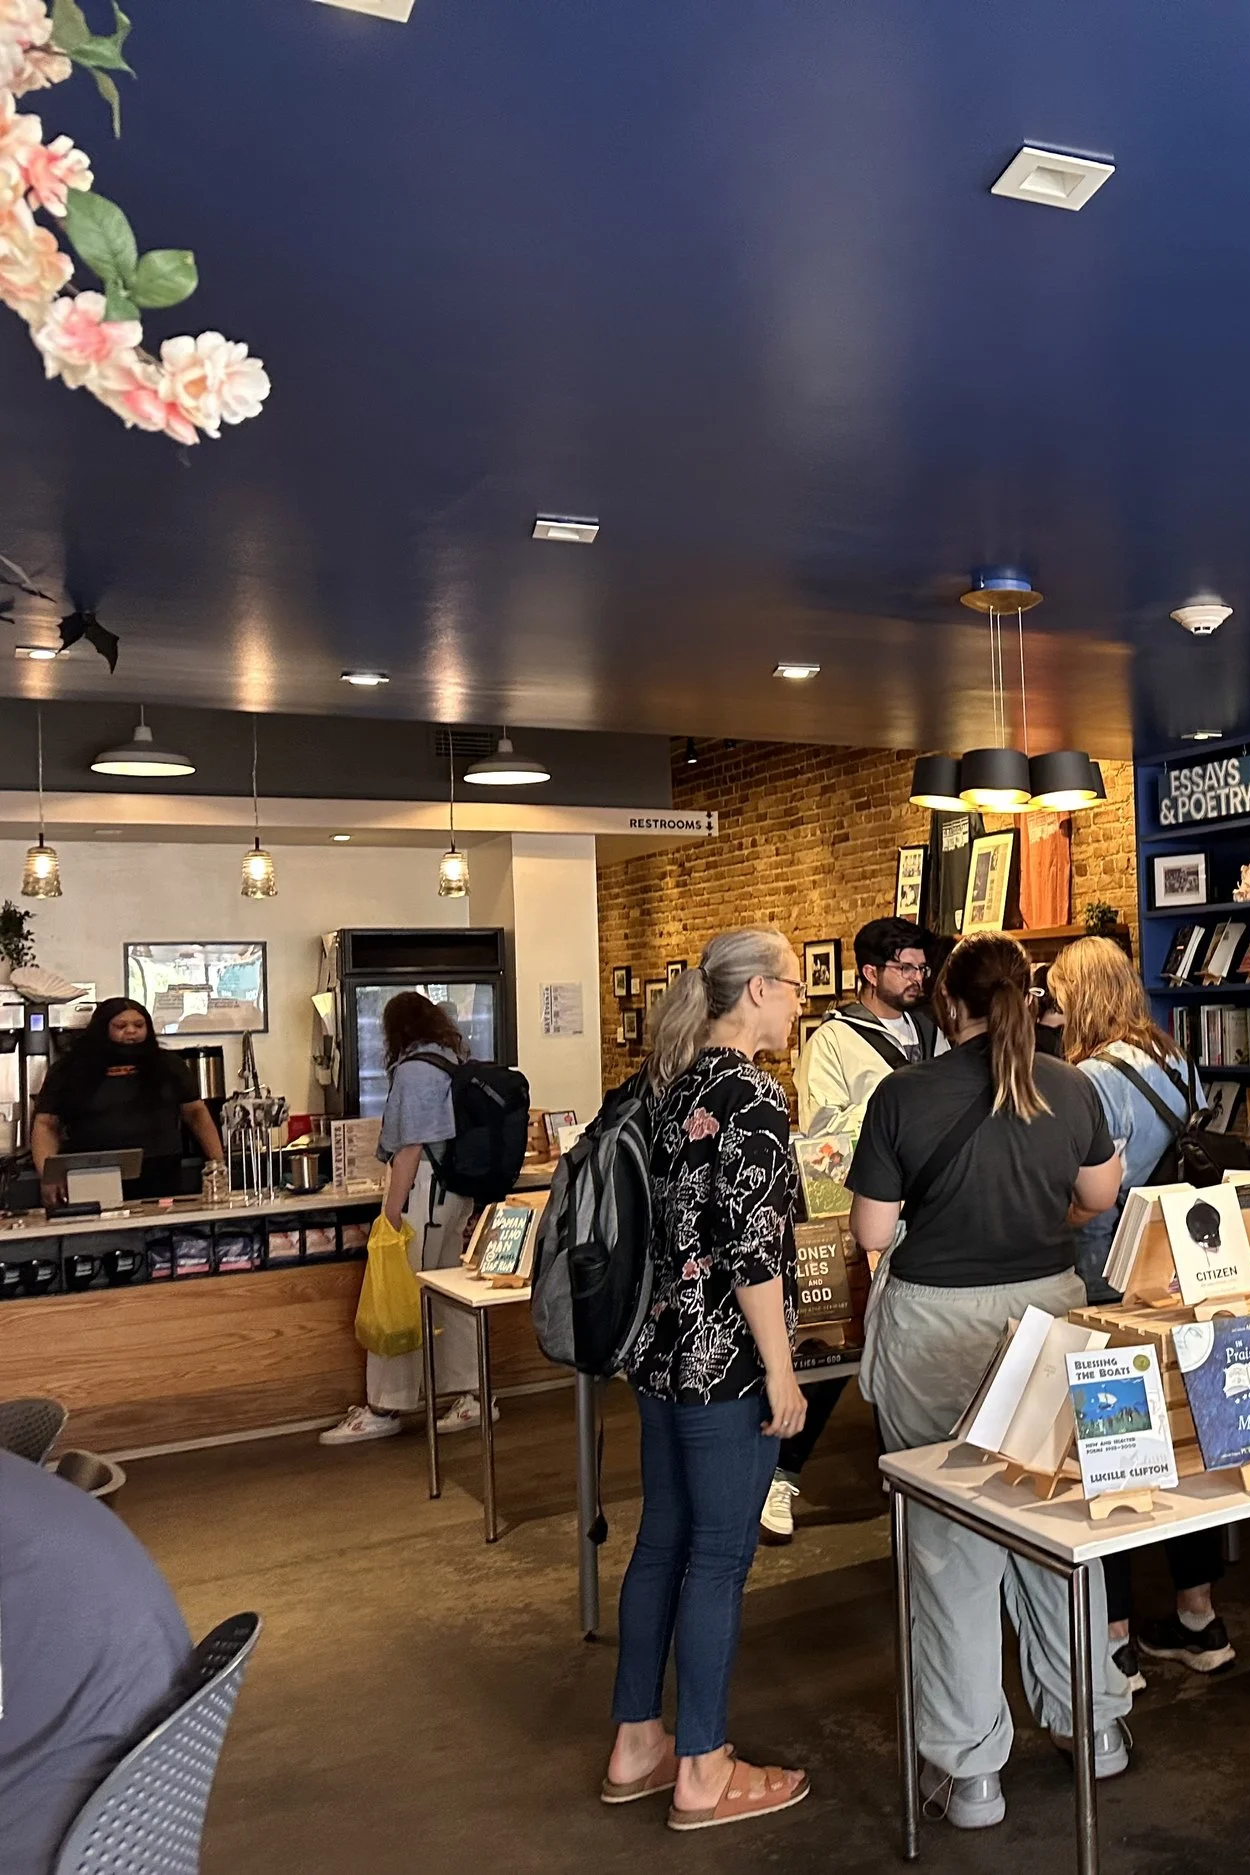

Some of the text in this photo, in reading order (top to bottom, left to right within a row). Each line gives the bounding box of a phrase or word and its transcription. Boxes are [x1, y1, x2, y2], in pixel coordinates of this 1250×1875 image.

[1169, 757, 1241, 798] ESSAYS
[629, 818, 702, 830] RESTROOMS
[491, 1216, 527, 1230] WOMAN
[485, 1240, 513, 1253] MAN
[797, 1243, 837, 1261] ONEY
[796, 1261, 829, 1278] LIES
[1195, 1265, 1238, 1282] CITIZEN
[808, 1278, 823, 1287] AND
[801, 1287, 832, 1304] GOD
[1235, 1339, 1243, 1347] IN
[1074, 1358, 1118, 1371] BLESSING
[1076, 1367, 1130, 1380] THE BOATS
[1090, 1463, 1169, 1483] LUCILLE CLIFTON
